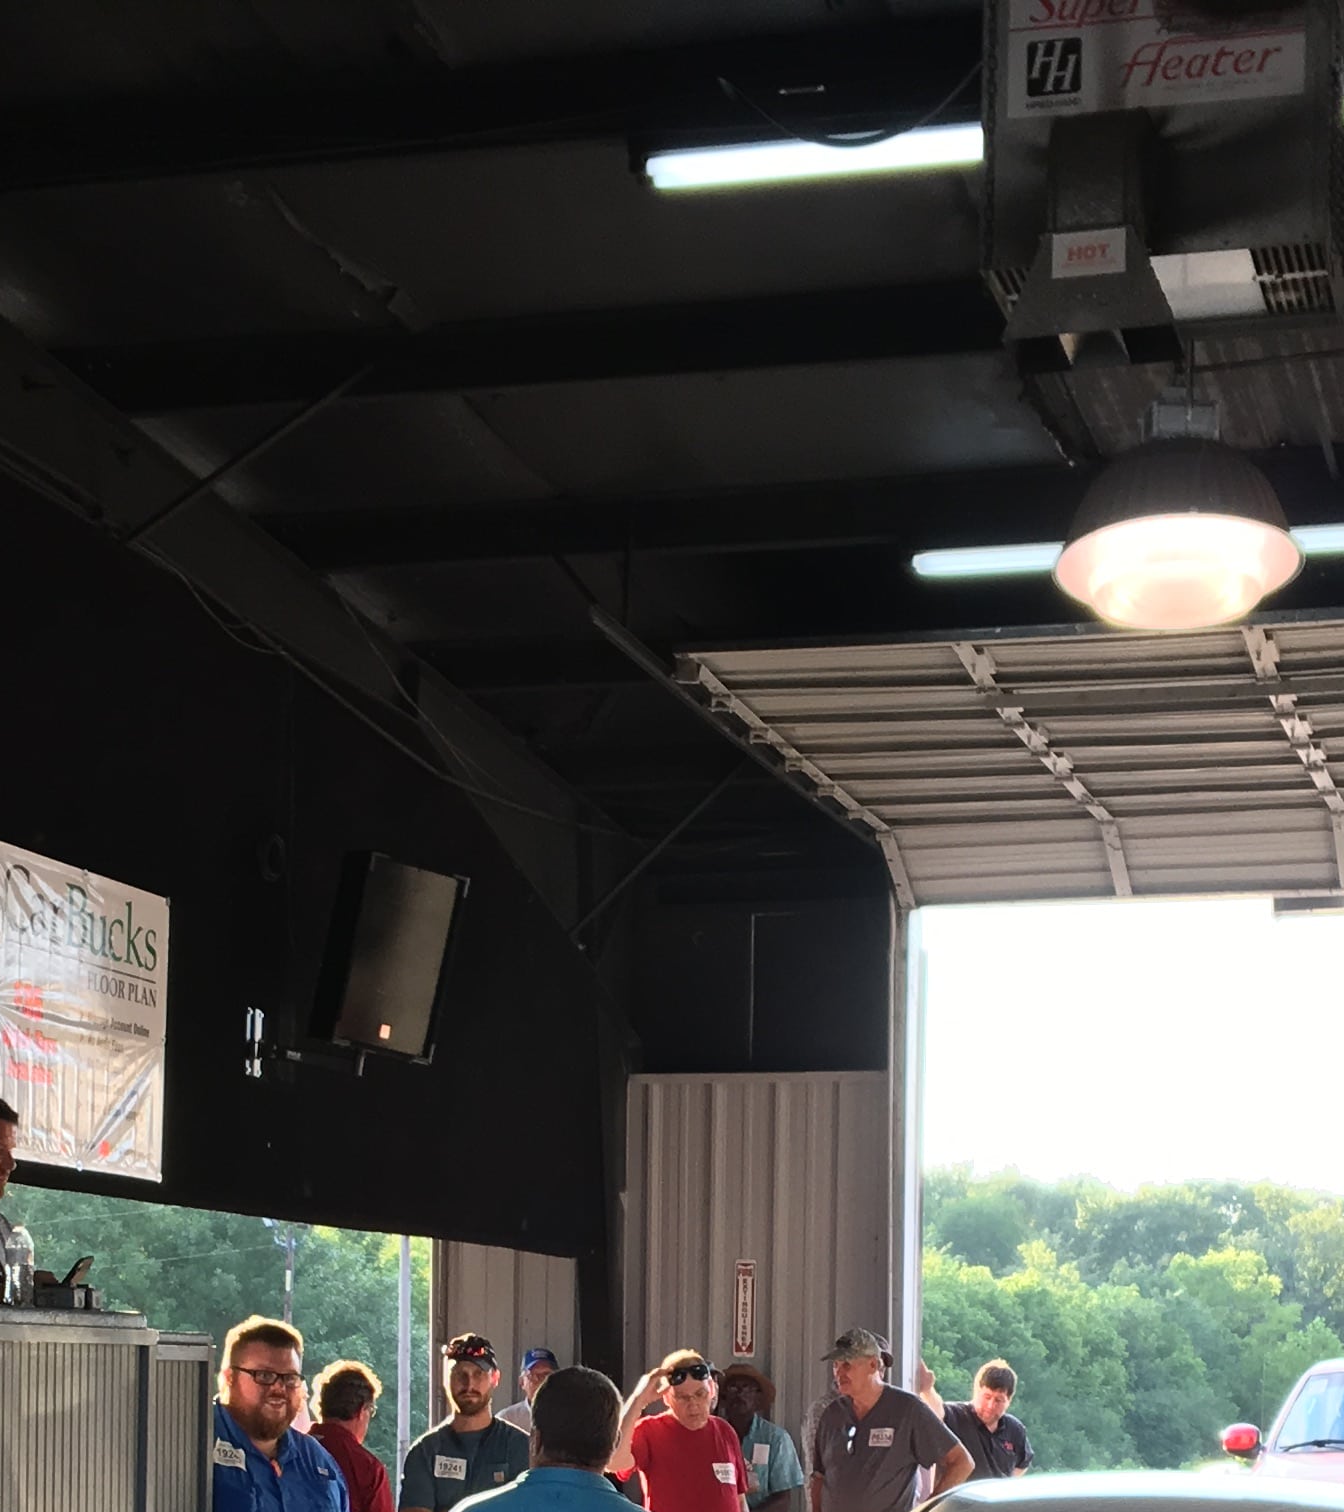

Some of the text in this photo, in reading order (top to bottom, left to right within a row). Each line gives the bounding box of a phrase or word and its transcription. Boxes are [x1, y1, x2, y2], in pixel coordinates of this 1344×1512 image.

[1119, 37, 1284, 88] Heater
[1067, 243, 1111, 262] HOT
[87, 972, 158, 1009] FLOOR PLAN
[737, 1267, 753, 1278] FIRE
[740, 1278, 750, 1347] EXTINGUISHER
[438, 1462, 463, 1473] 19241
